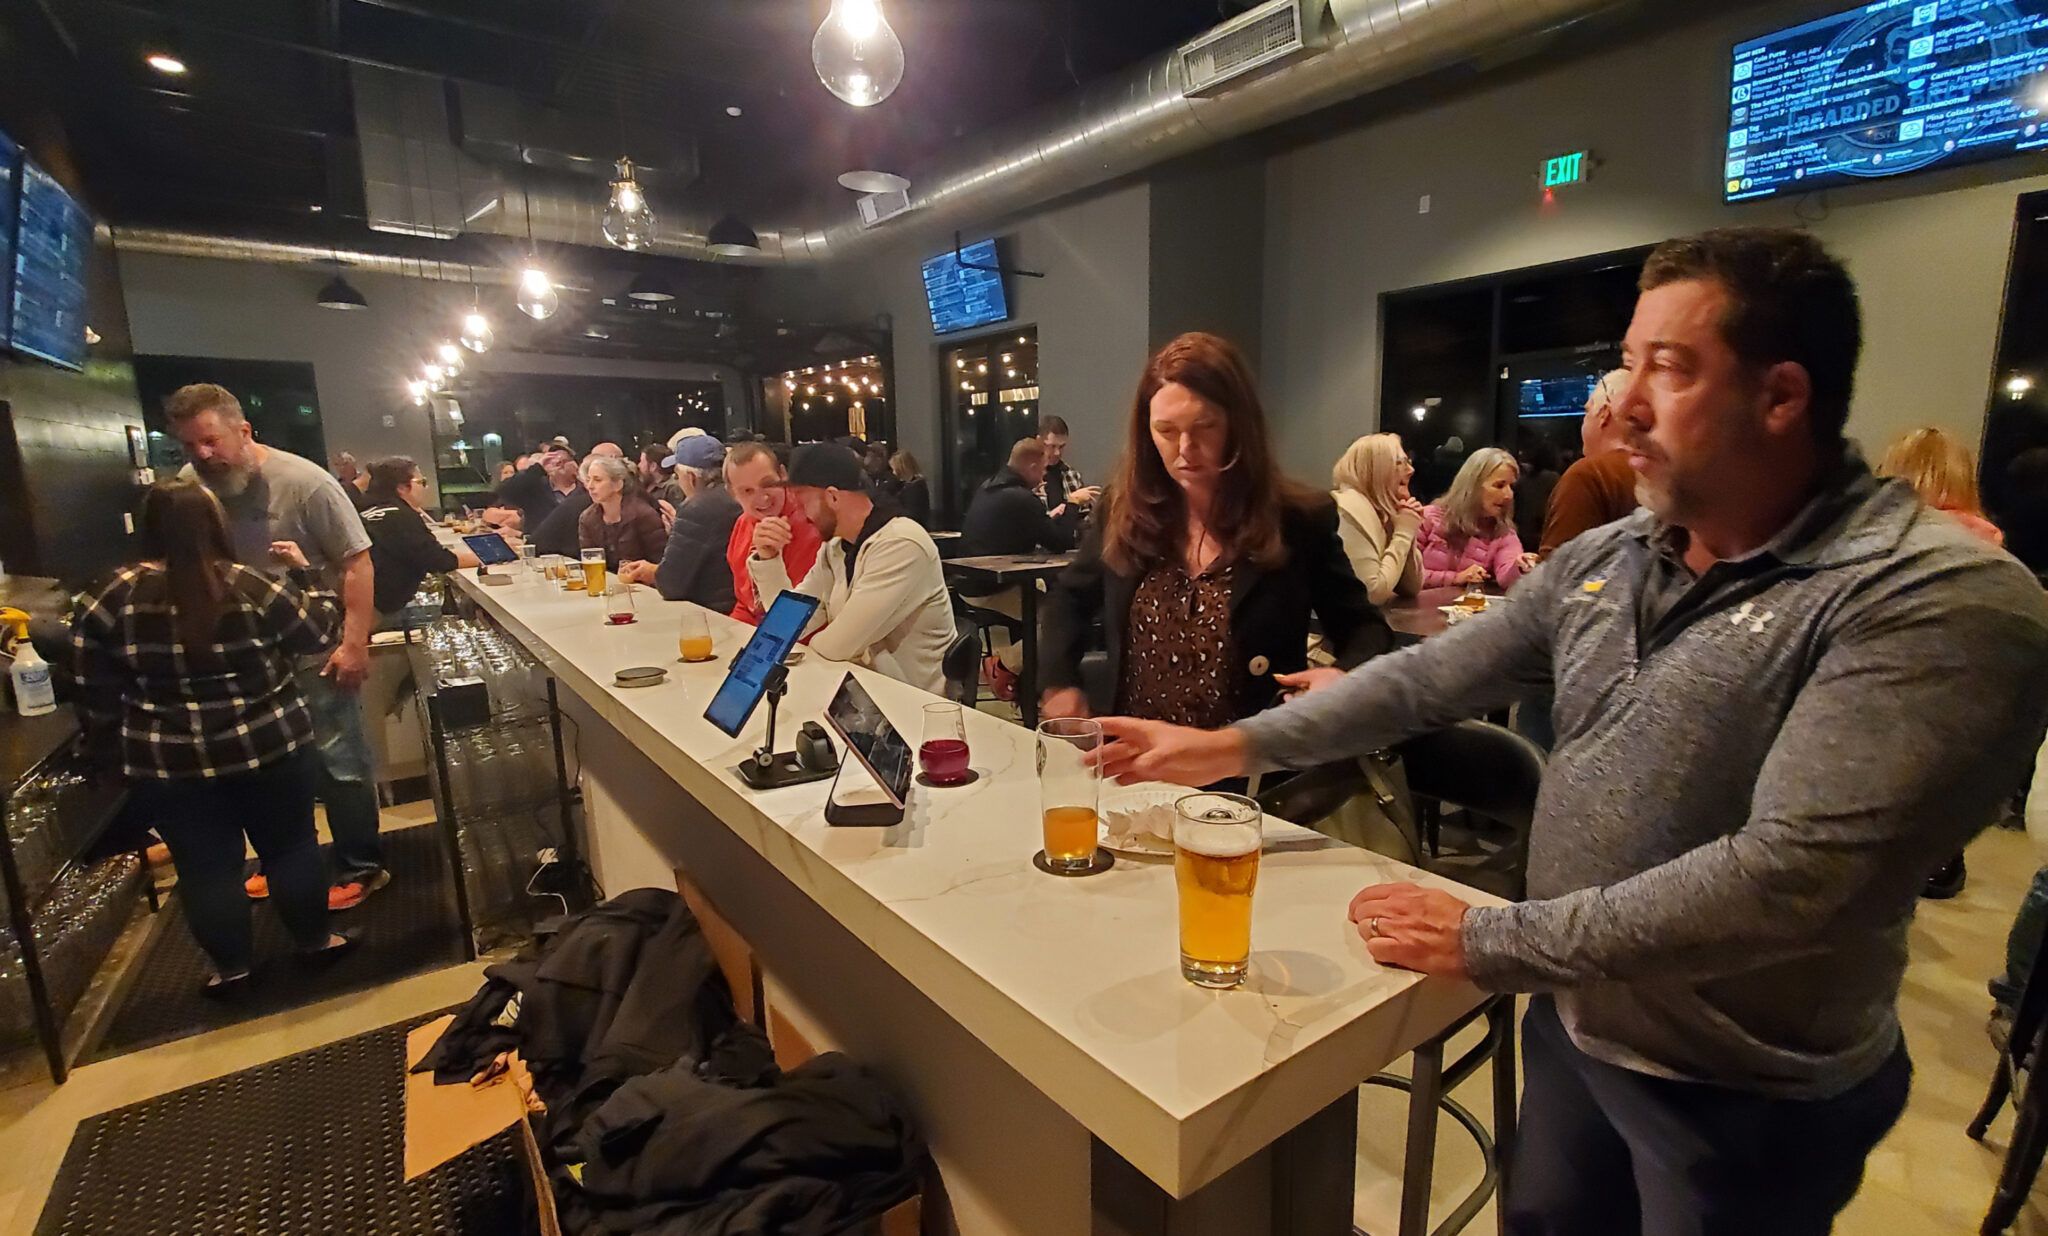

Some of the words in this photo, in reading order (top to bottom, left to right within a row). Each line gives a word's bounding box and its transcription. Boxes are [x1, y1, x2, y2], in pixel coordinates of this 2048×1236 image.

[1936, 20, 1984, 38] Nightingale
[1800, 64, 1819, 73] Coast
[1930, 66, 1964, 80] Carnival
[1990, 52, 2035, 66] Blueberry
[1832, 80, 1846, 89] And
[1946, 107, 1974, 118] Colada
[1747, 154, 1767, 162] Airport
[1545, 152, 1583, 187] EXIT
